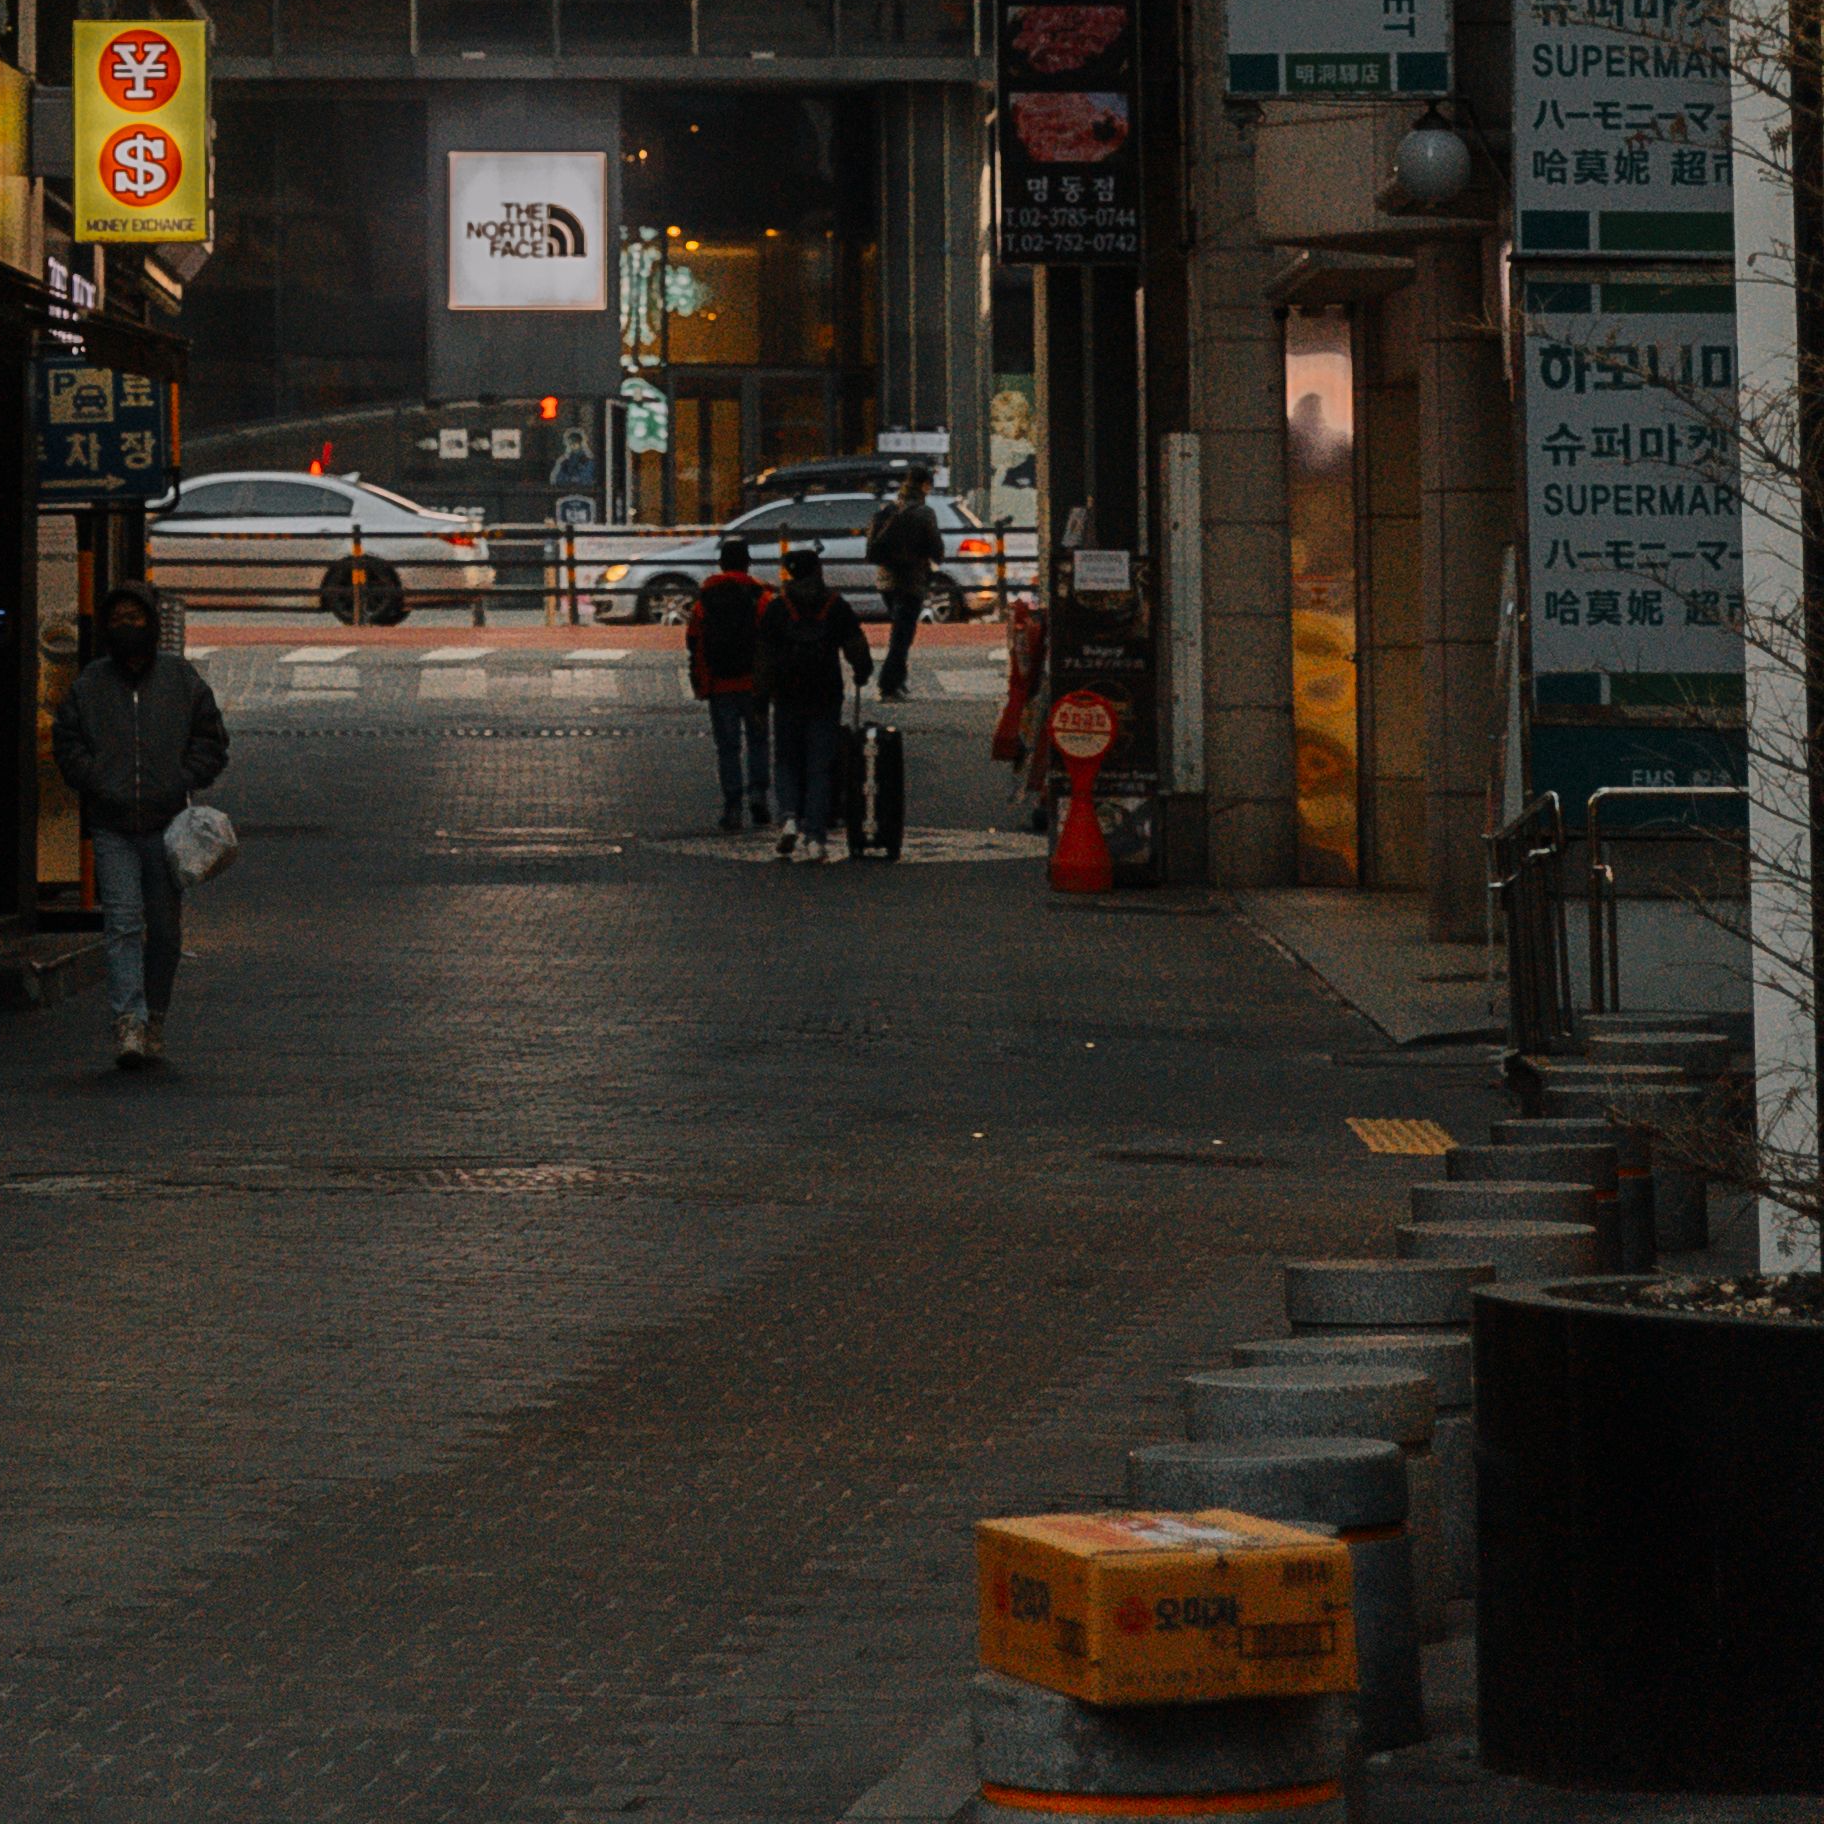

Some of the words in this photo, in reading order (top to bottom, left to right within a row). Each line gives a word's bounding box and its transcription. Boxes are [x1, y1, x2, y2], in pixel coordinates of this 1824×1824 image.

[1532, 148, 1651, 186] 哈莫妮
[1025, 174, 1116, 204] 명동점
[502, 202, 544, 220] THE
[86, 217, 128, 233] MONEY
[131, 217, 196, 233] EXCHANGE
[466, 221, 544, 240] NORTH
[489, 240, 544, 259] FACE
[1004, 232, 1139, 254] T.02-752-0742
[54, 373, 75, 396] P
[1544, 589, 1665, 627] 哈莫妮
